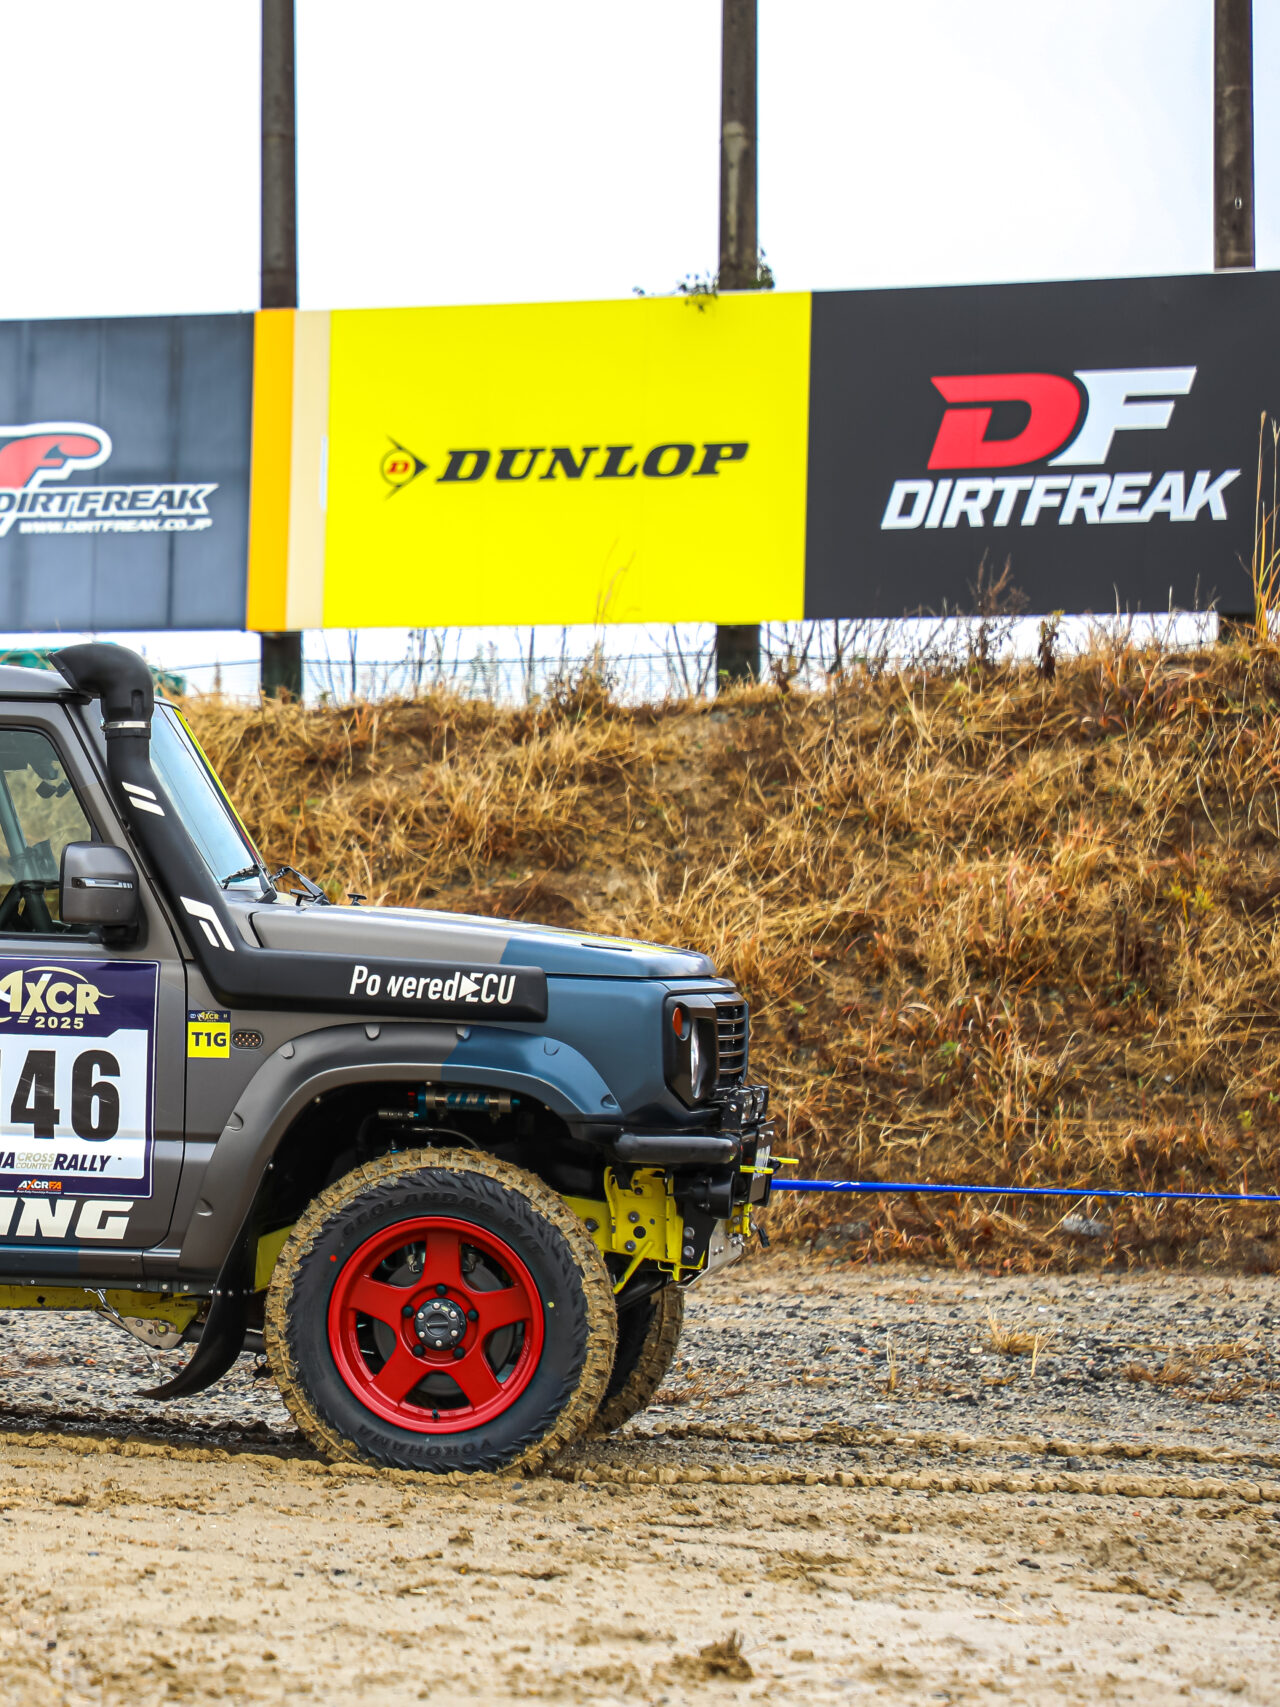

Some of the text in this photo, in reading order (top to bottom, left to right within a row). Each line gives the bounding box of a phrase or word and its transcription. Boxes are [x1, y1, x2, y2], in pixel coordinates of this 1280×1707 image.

[928, 366, 1197, 470] DF
[436, 442, 749, 484] DUNLOP
[881, 469, 1242, 530] DIRTFREAK
[35, 1016, 84, 1030] 2025
[191, 1032, 226, 1047] T1G
[16, 1162, 53, 1170] COUNTRY
[17, 1152, 55, 1162] CROSS
[53, 1153, 111, 1172] RALLY
[356, 1424, 493, 1459] YOKOHAMA
